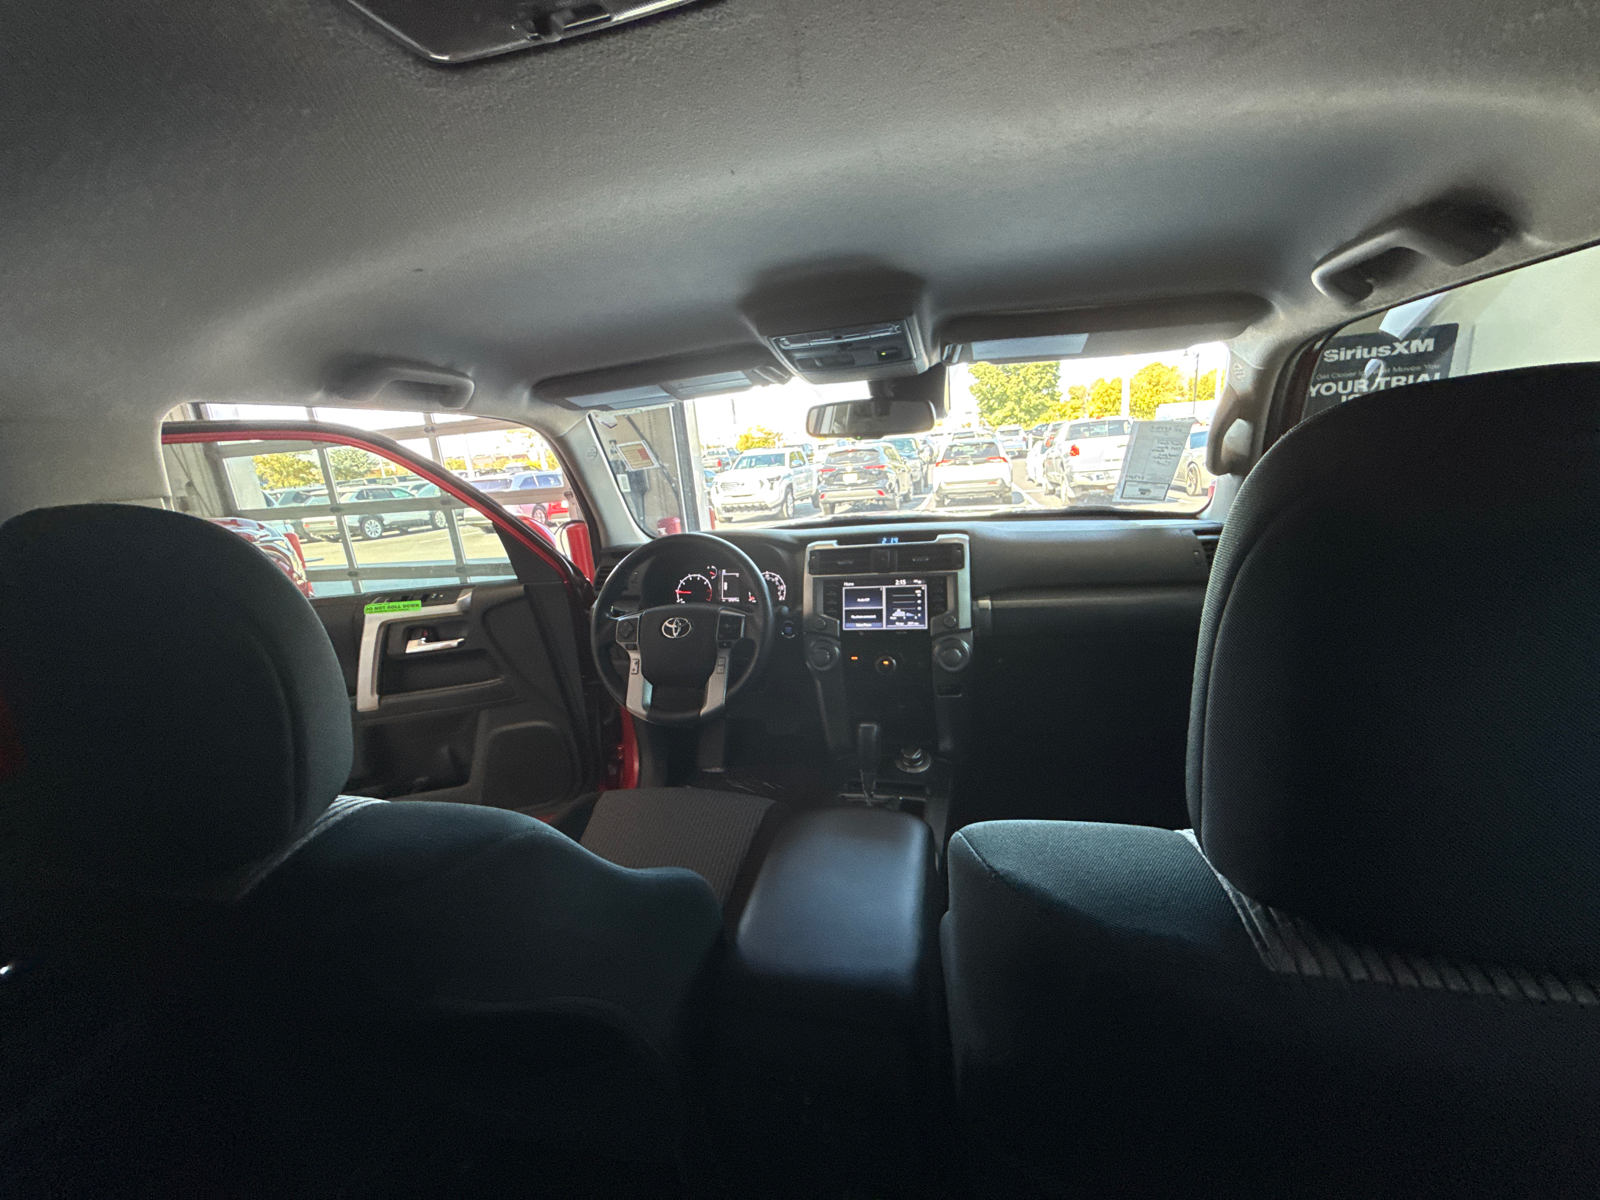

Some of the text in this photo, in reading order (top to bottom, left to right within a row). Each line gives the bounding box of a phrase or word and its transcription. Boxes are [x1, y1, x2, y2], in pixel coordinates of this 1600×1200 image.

[1323, 338, 1435, 363] SiriusXM
[1392, 364, 1421, 373] Moves
[1309, 379, 1370, 397] YOUR
